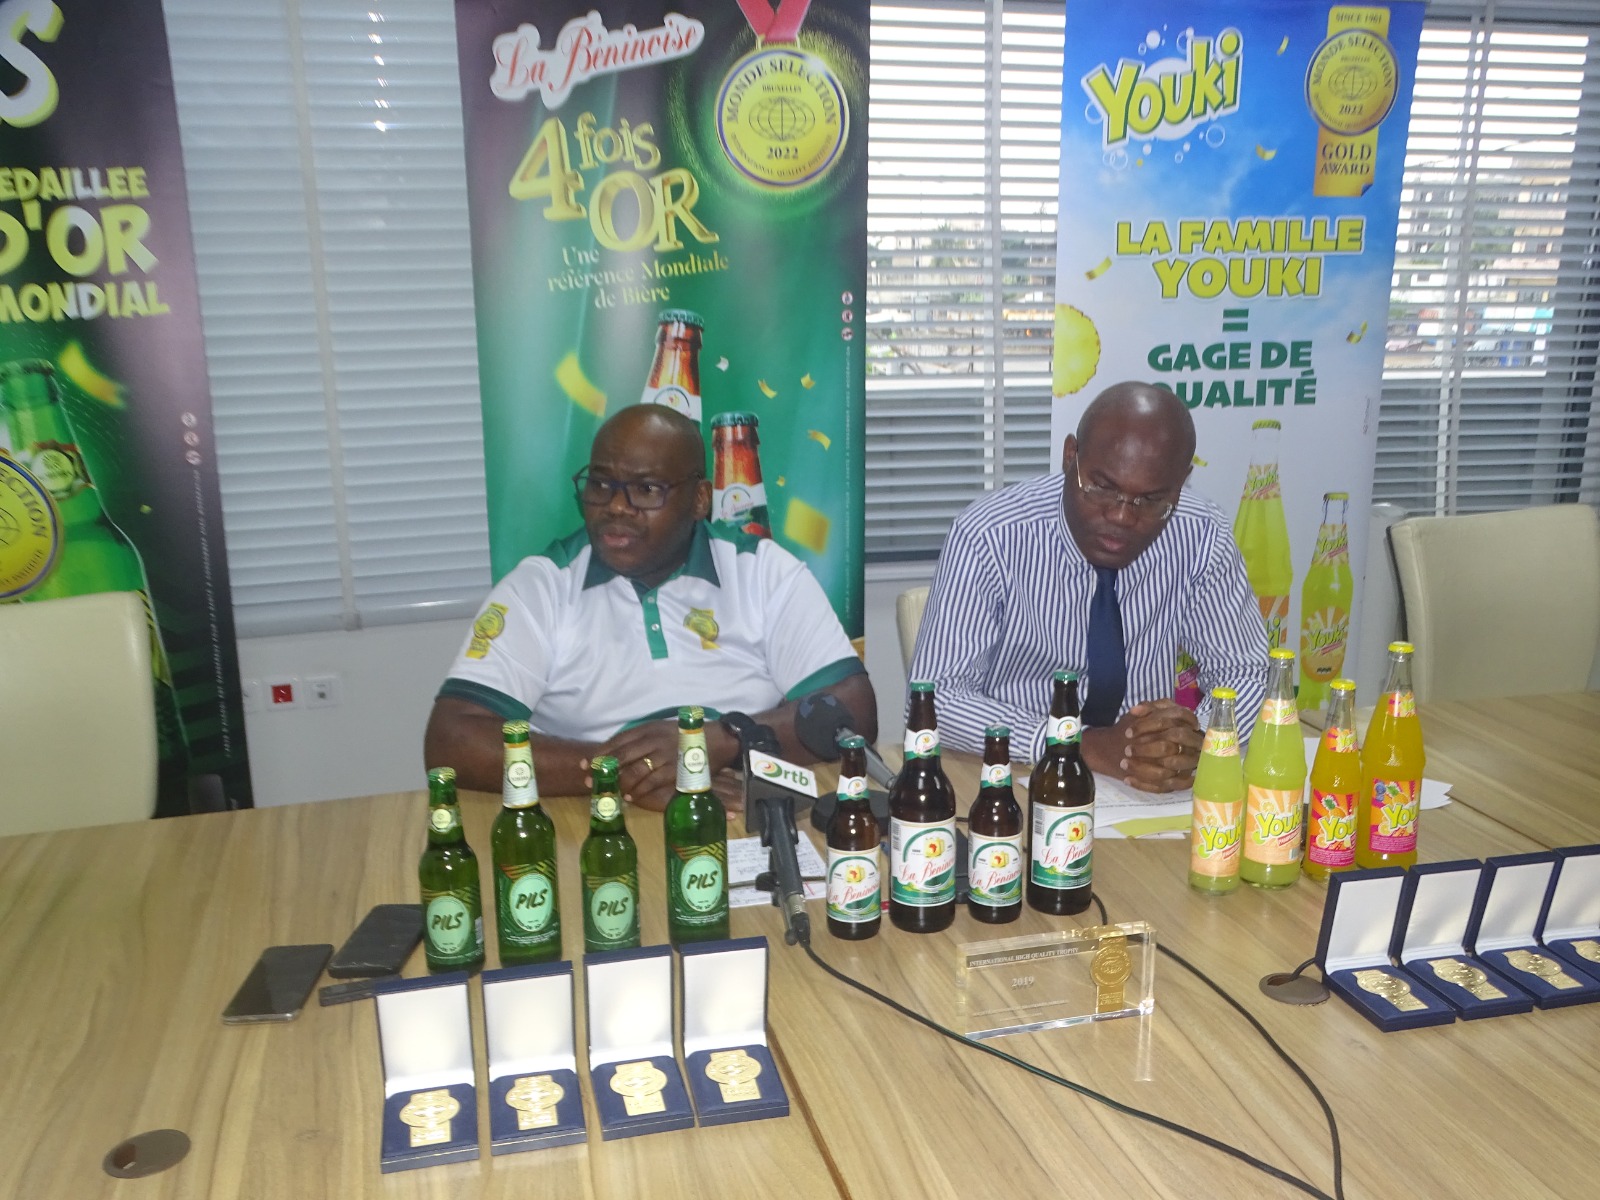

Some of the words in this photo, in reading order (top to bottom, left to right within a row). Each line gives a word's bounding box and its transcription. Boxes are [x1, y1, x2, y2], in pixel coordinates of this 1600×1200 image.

[495, 35, 546, 90] La
[726, 60, 767, 124] MONDE
[1085, 28, 1242, 146] Youki
[767, 146, 799, 160] 2022
[1322, 142, 1372, 162] GOLD
[508, 116, 587, 221] 4
[574, 111, 661, 170] fois
[1320, 162, 1370, 176] AWARD
[588, 168, 720, 253] OR
[1116, 221, 1172, 255] LA
[1178, 218, 1364, 255] FAMILLE
[561, 246, 600, 267] Une
[641, 250, 729, 280] Mondiale
[1152, 256, 1323, 299] YOUKI
[595, 287, 616, 309] de
[1147, 342, 1251, 372] GAGE
[1260, 341, 1312, 369] DE
[1152, 369, 1317, 410] UALITÉ
[686, 870, 718, 890] PILS
[515, 888, 548, 910] PILS
[597, 897, 629, 916] PILS
[431, 912, 464, 931] PILS
[969, 955, 1014, 967] INTERNATIONAL
[1015, 953, 1030, 961] HIGH
[1031, 950, 1056, 959] QUALITY
[1056, 947, 1079, 956] TROPHY
[1012, 976, 1034, 987] 2019
